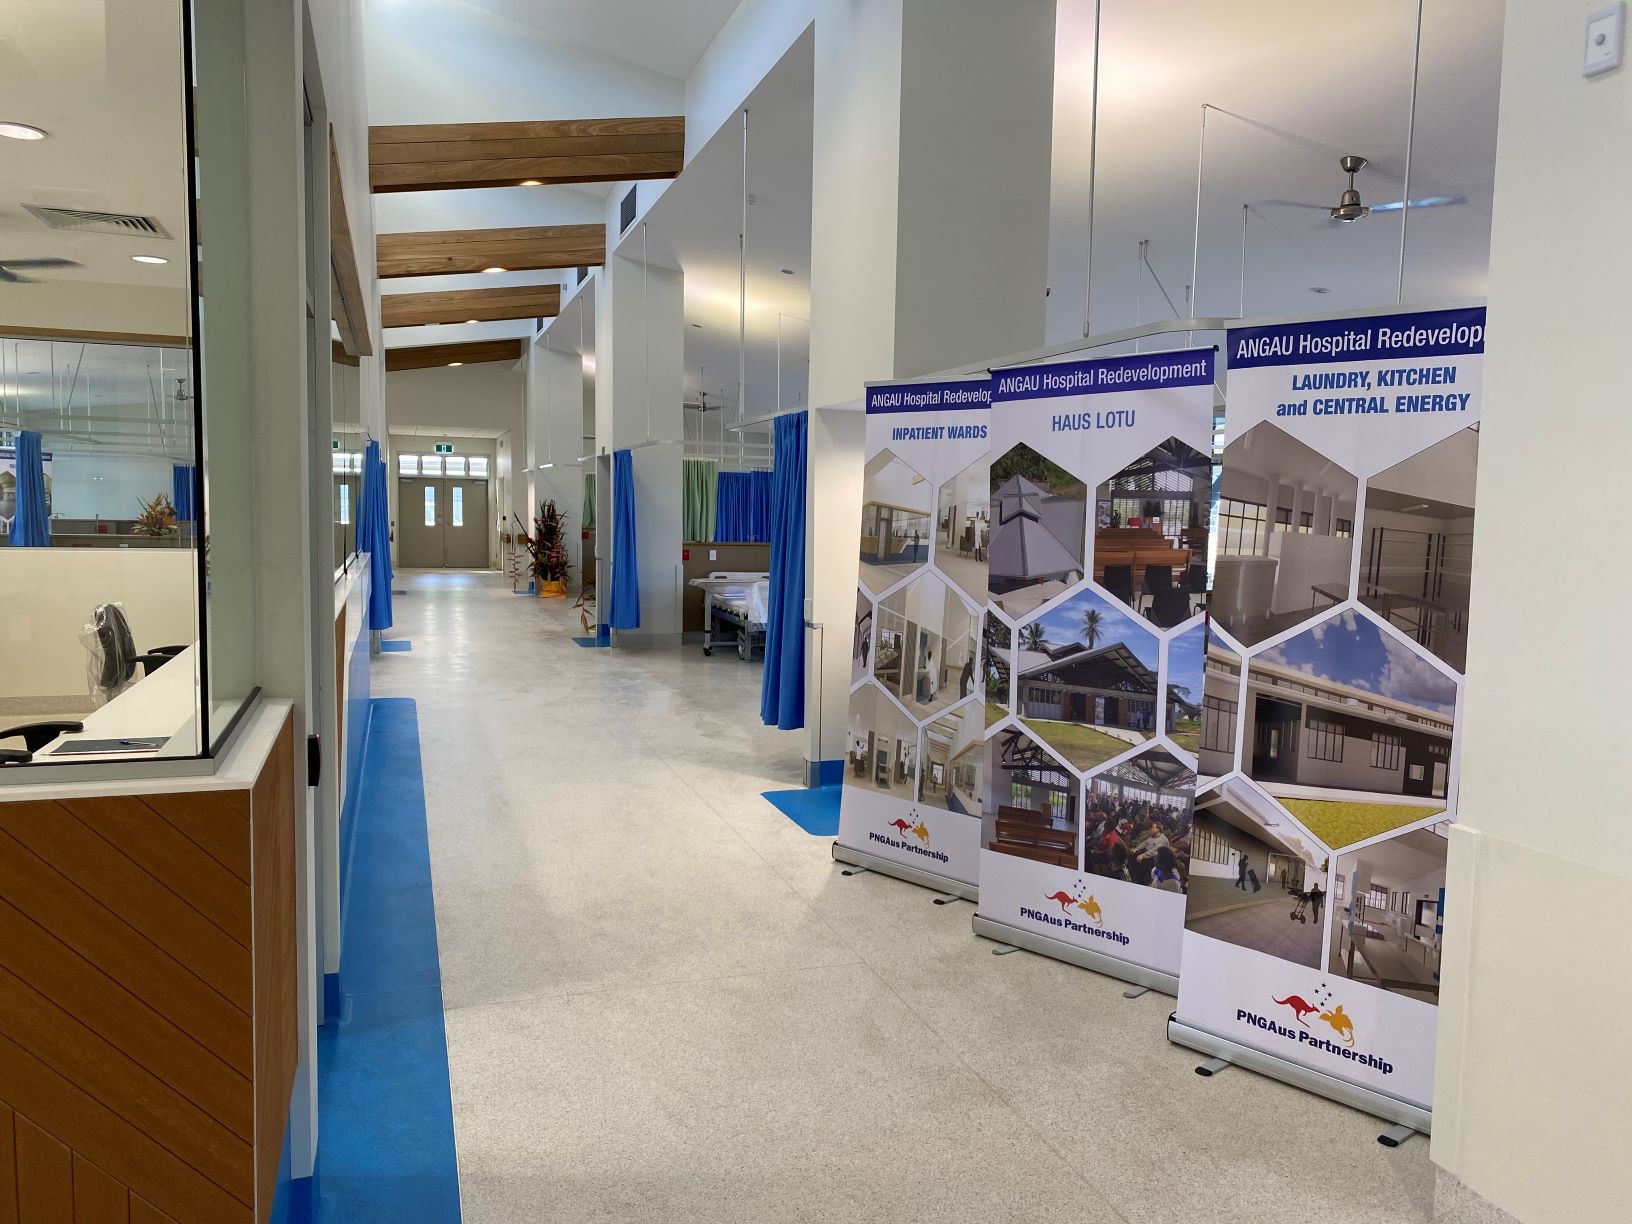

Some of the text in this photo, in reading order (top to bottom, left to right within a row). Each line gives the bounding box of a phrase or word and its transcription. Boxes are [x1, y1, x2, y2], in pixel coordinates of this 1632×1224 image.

[1236, 322, 1487, 359] ANGAU Hospital Redevelop
[998, 359, 1208, 395] ANGAU Hospital Redevelopment
[1292, 366, 1457, 391] LAUNDRY, KITCHEN
[871, 391, 902, 408] ANGAU
[903, 390, 941, 407] Hospital
[1276, 393, 1471, 416] and CENTRAL ENERGY
[892, 424, 988, 441] INPATIENT WARDS
[1052, 409, 1136, 432] HAUS LOTU
[869, 832, 949, 864] PNGAus Partnership
[1020, 907, 1130, 946] PNGAus Partnership
[1236, 1009, 1393, 1075] PNGAus Partnership
